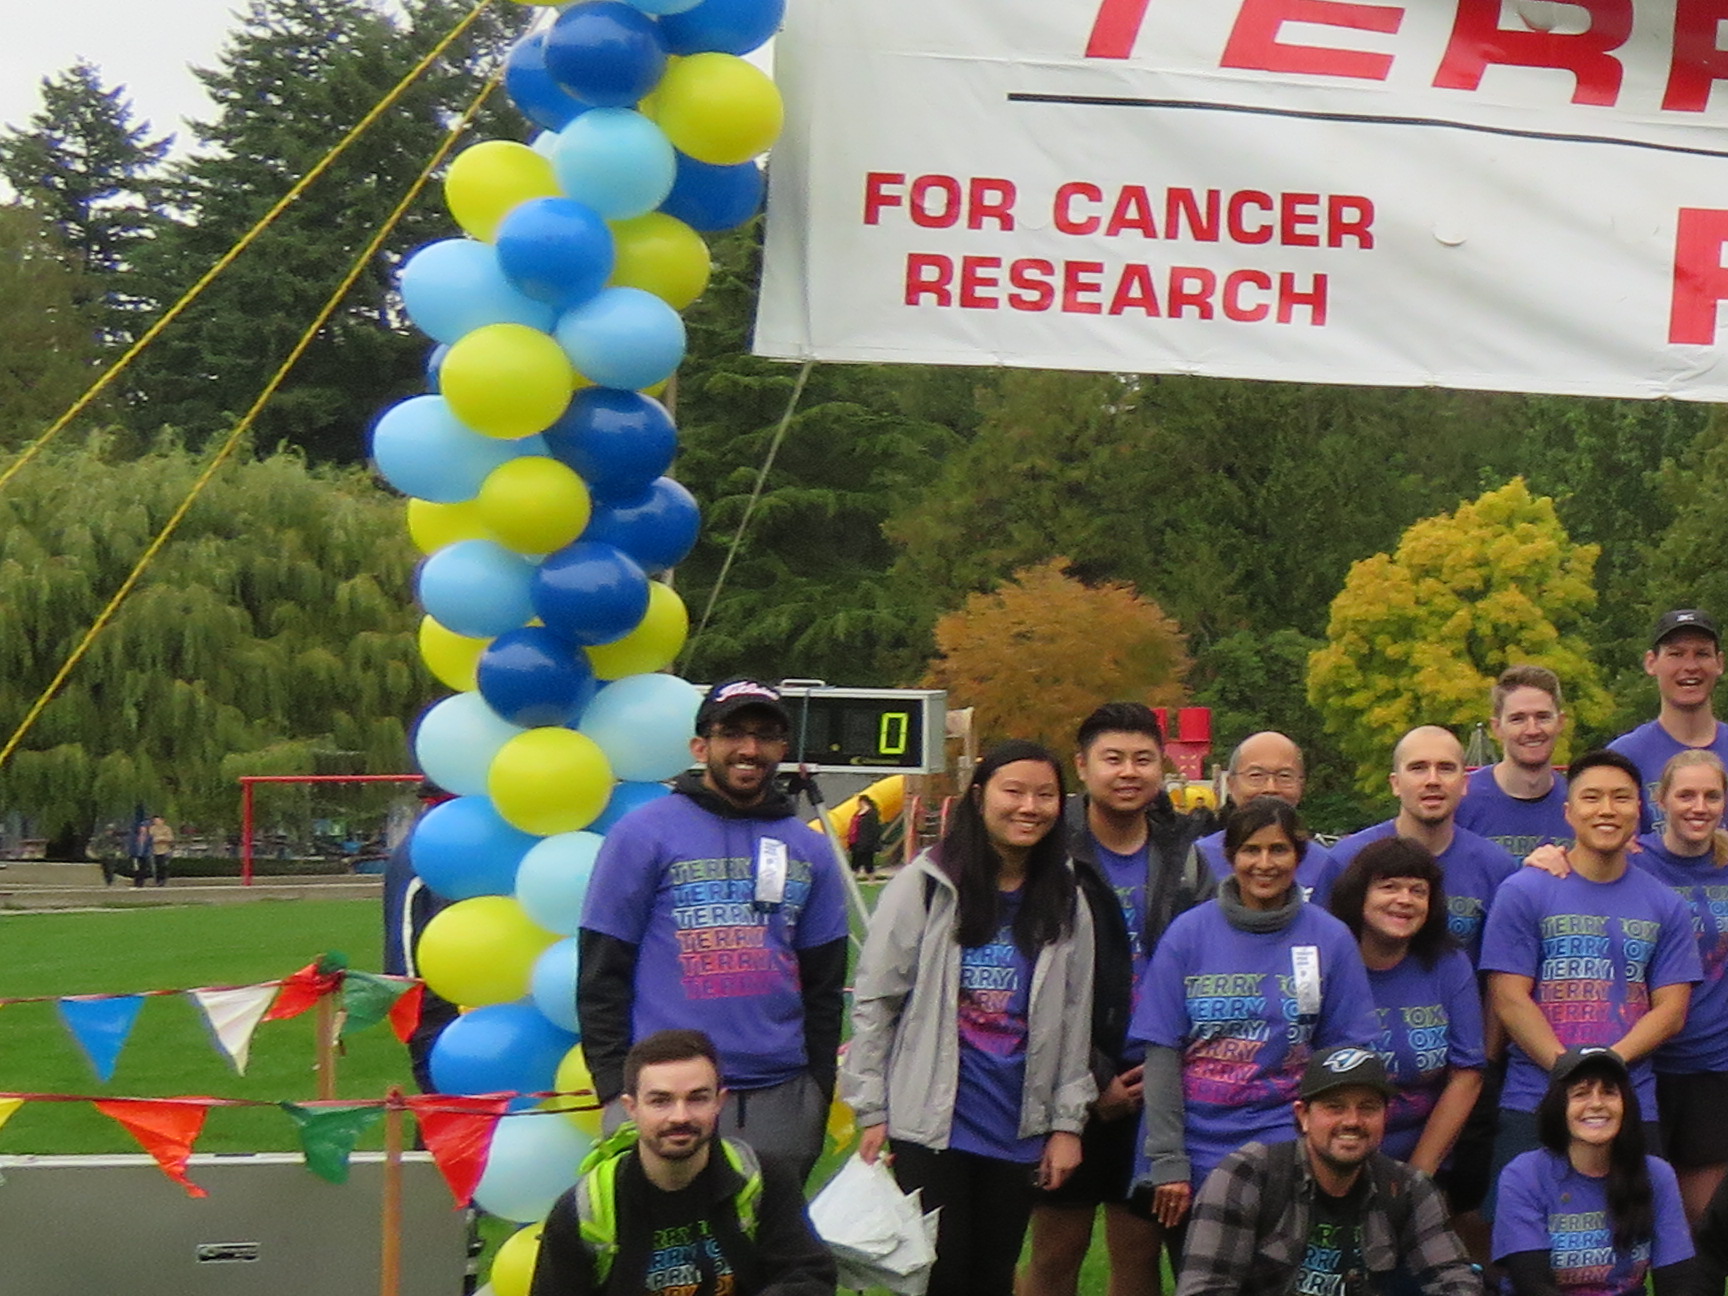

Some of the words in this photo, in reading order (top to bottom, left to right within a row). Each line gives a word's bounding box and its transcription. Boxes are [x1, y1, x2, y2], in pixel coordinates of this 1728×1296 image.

[864, 172, 1017, 232] FOR
[1053, 181, 1375, 249] CANCER
[905, 253, 1328, 326] RESEARCH
[878, 712, 909, 755] 0
[1446, 895, 1483, 918] OX
[1541, 913, 1611, 939] TERRY
[1617, 916, 1661, 943] OX
[1540, 934, 1611, 959] TERRY
[960, 965, 1018, 991] RRY
[1542, 956, 1613, 981] TERRY
[1184, 973, 1269, 999] TERRY
[1399, 1004, 1449, 1029] OX
[1406, 1025, 1448, 1051] OX
[1549, 1228, 1611, 1252] ERRY
[1550, 1245, 1614, 1269] ERRY
